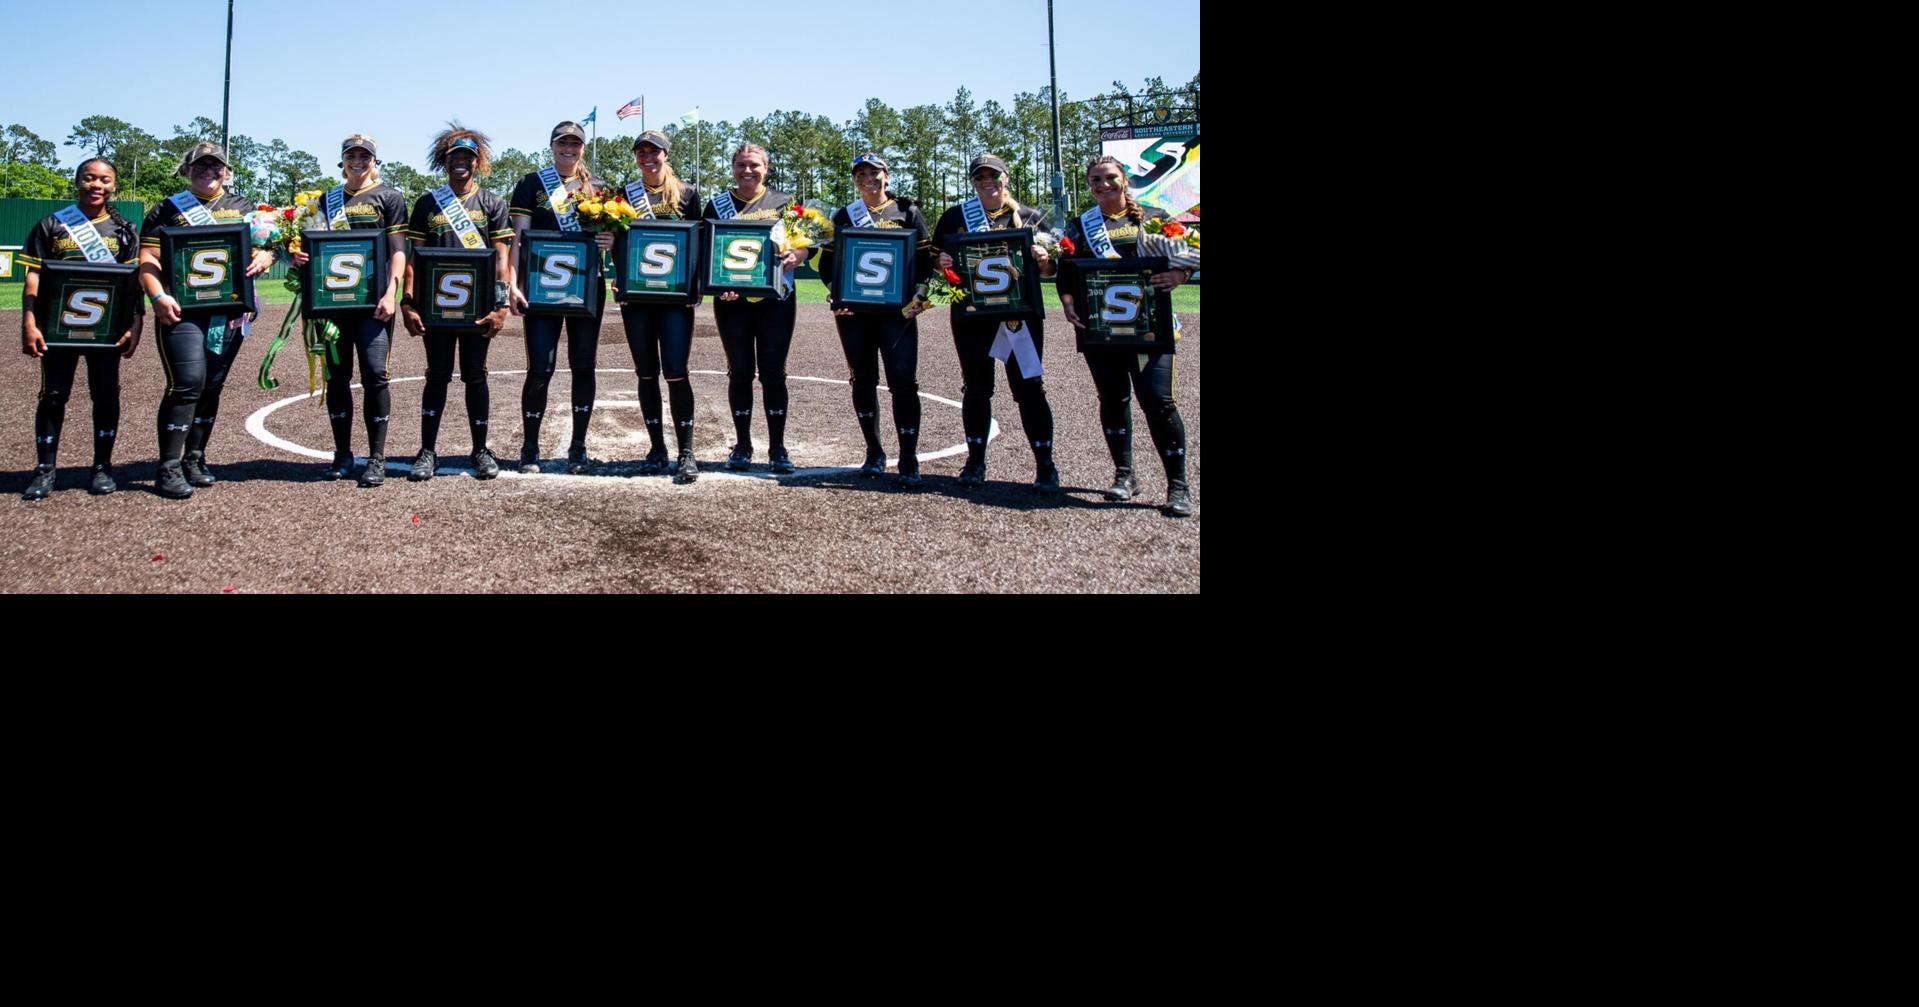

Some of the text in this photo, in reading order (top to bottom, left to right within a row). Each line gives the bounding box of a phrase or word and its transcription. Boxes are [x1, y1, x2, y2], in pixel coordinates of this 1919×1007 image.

[1134, 124, 1193, 134] SOUTHEASTERN
[539, 167, 562, 196] LION
[328, 188, 343, 219] IONS
[439, 194, 471, 231] LIONS
[964, 197, 987, 231] LION
[1084, 216, 1110, 255] LIONS
[187, 249, 229, 288] S
[324, 253, 365, 291] S
[539, 253, 578, 289] S
[639, 242, 678, 276] S
[722, 238, 763, 272] S
[854, 251, 894, 287] S
[434, 272, 476, 309] S
[973, 256, 1011, 295] S
[61, 288, 109, 327] S
[1101, 284, 1143, 324] S
